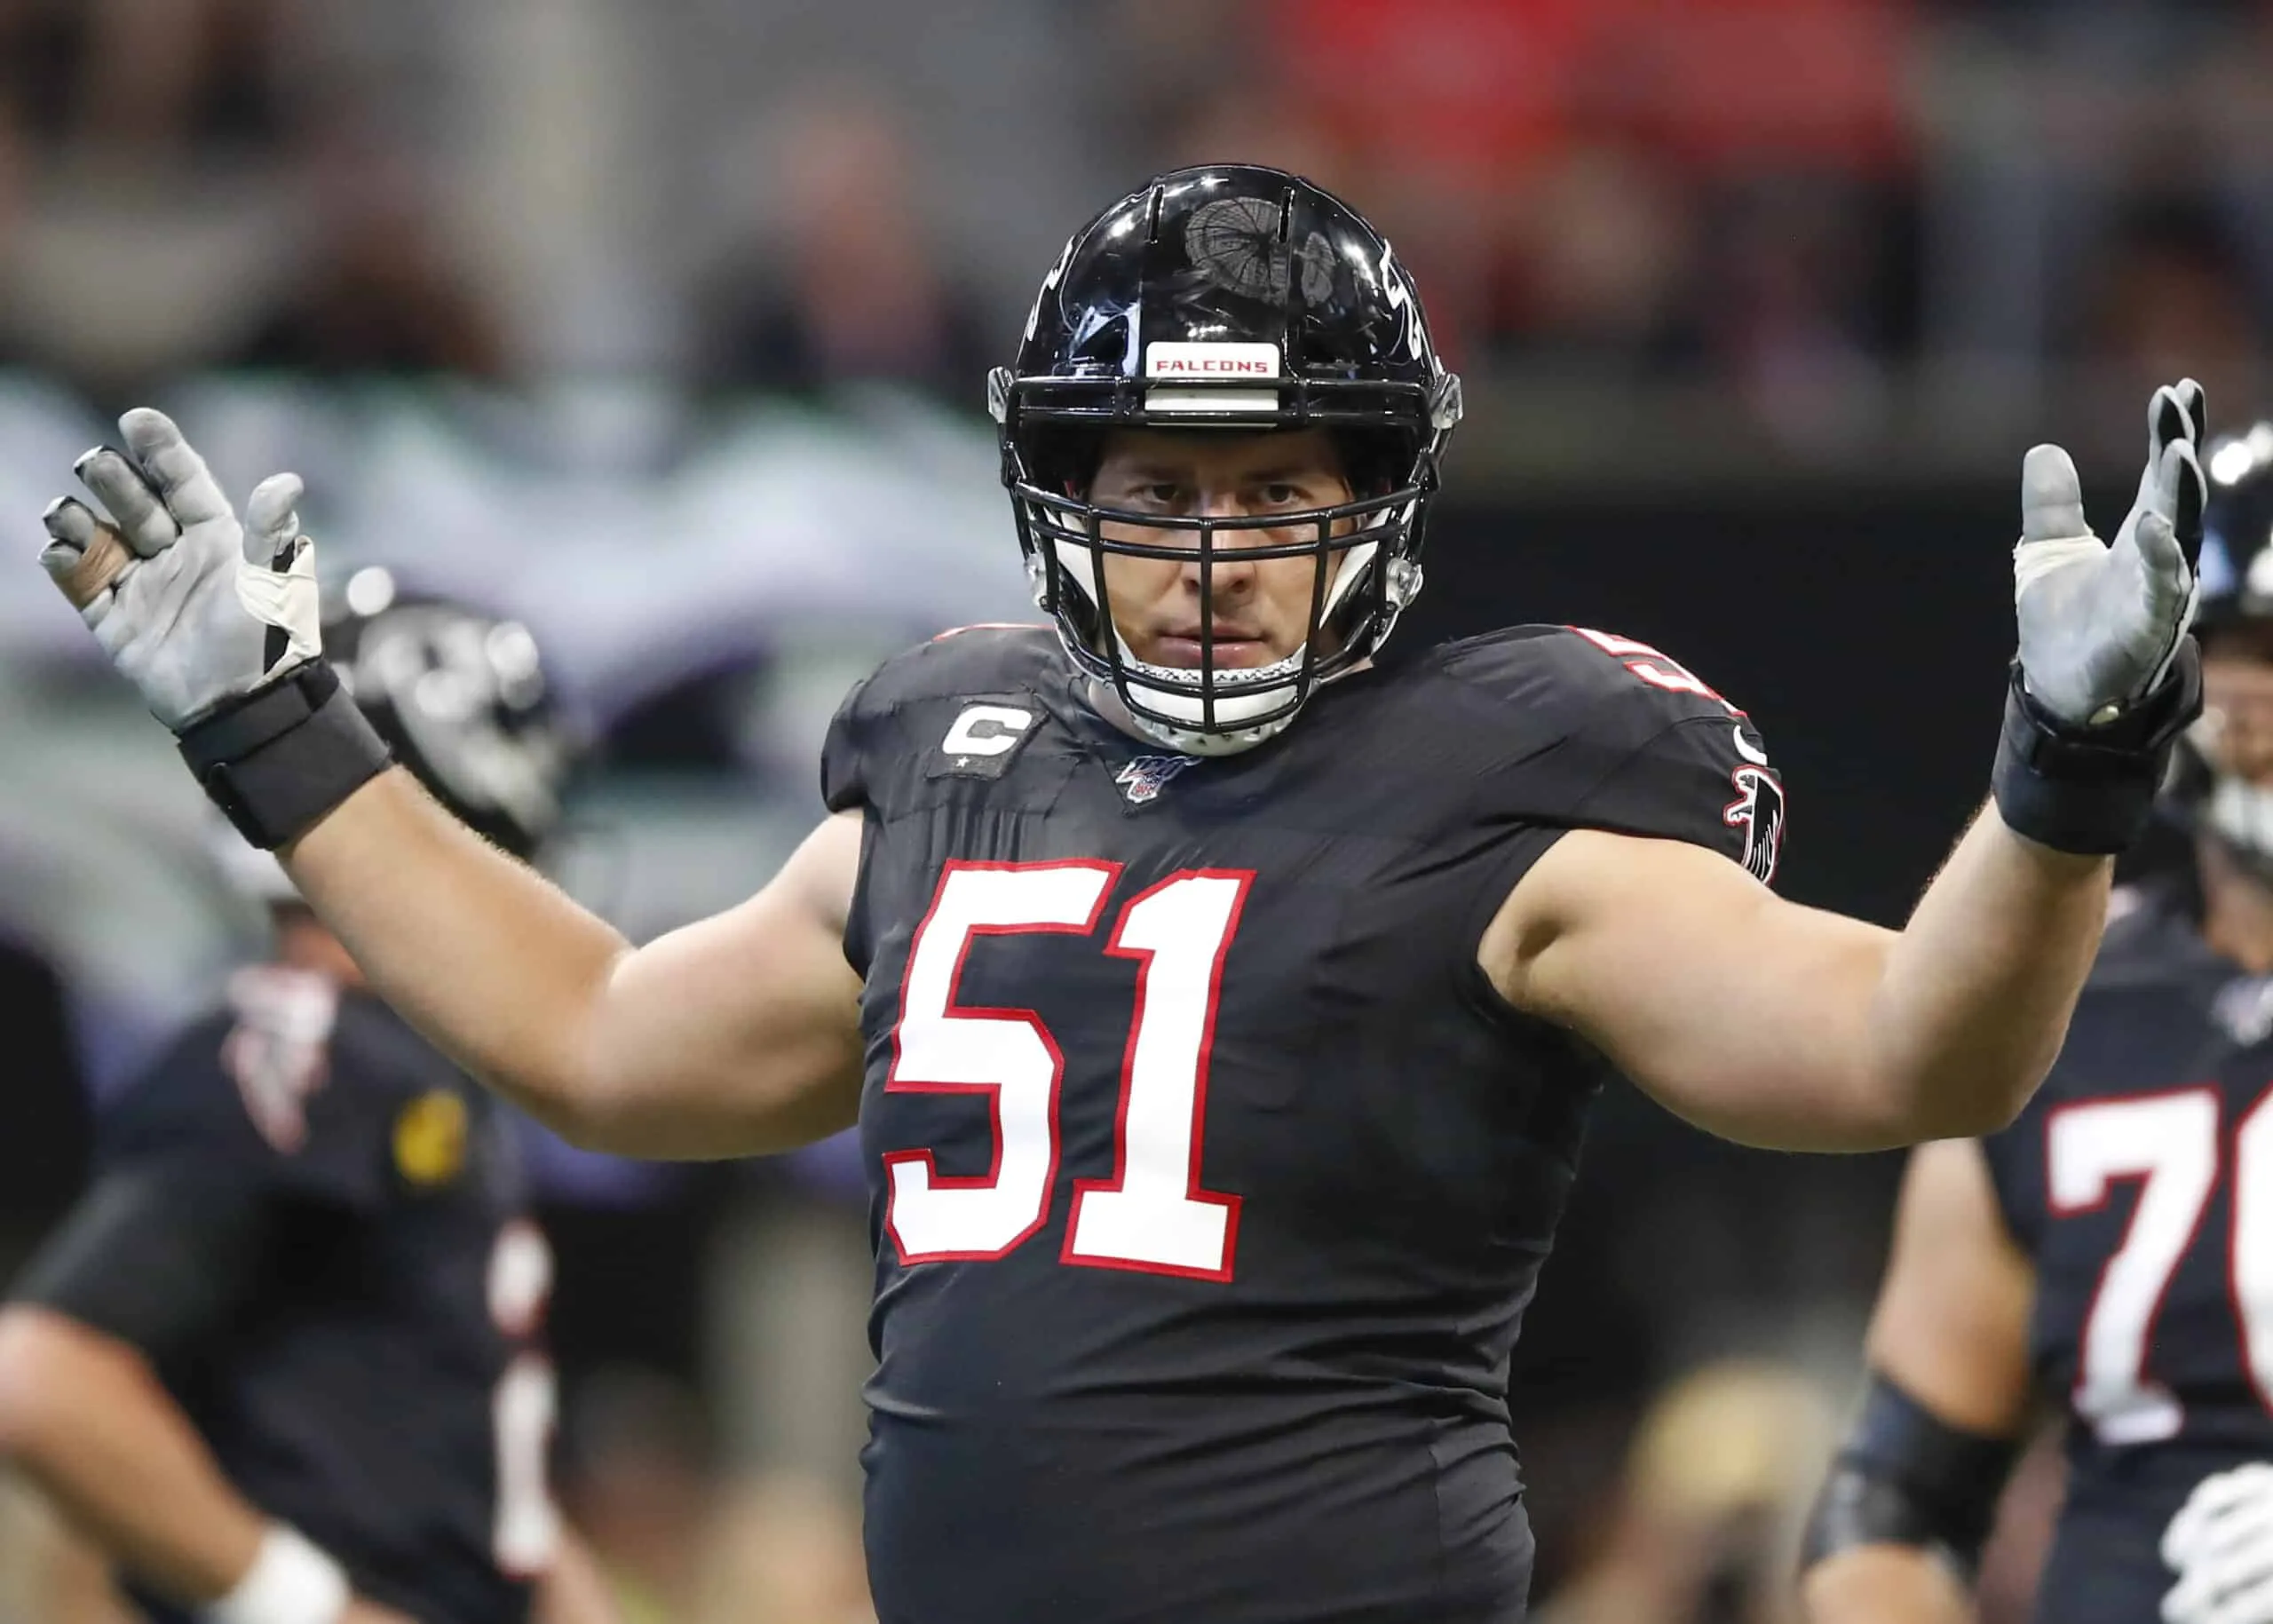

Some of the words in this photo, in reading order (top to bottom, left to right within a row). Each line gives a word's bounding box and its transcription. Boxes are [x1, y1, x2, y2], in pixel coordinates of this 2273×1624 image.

[1156, 360, 1268, 373] FALCONS
[941, 706, 1032, 755] C
[883, 859, 1257, 1282] 51
